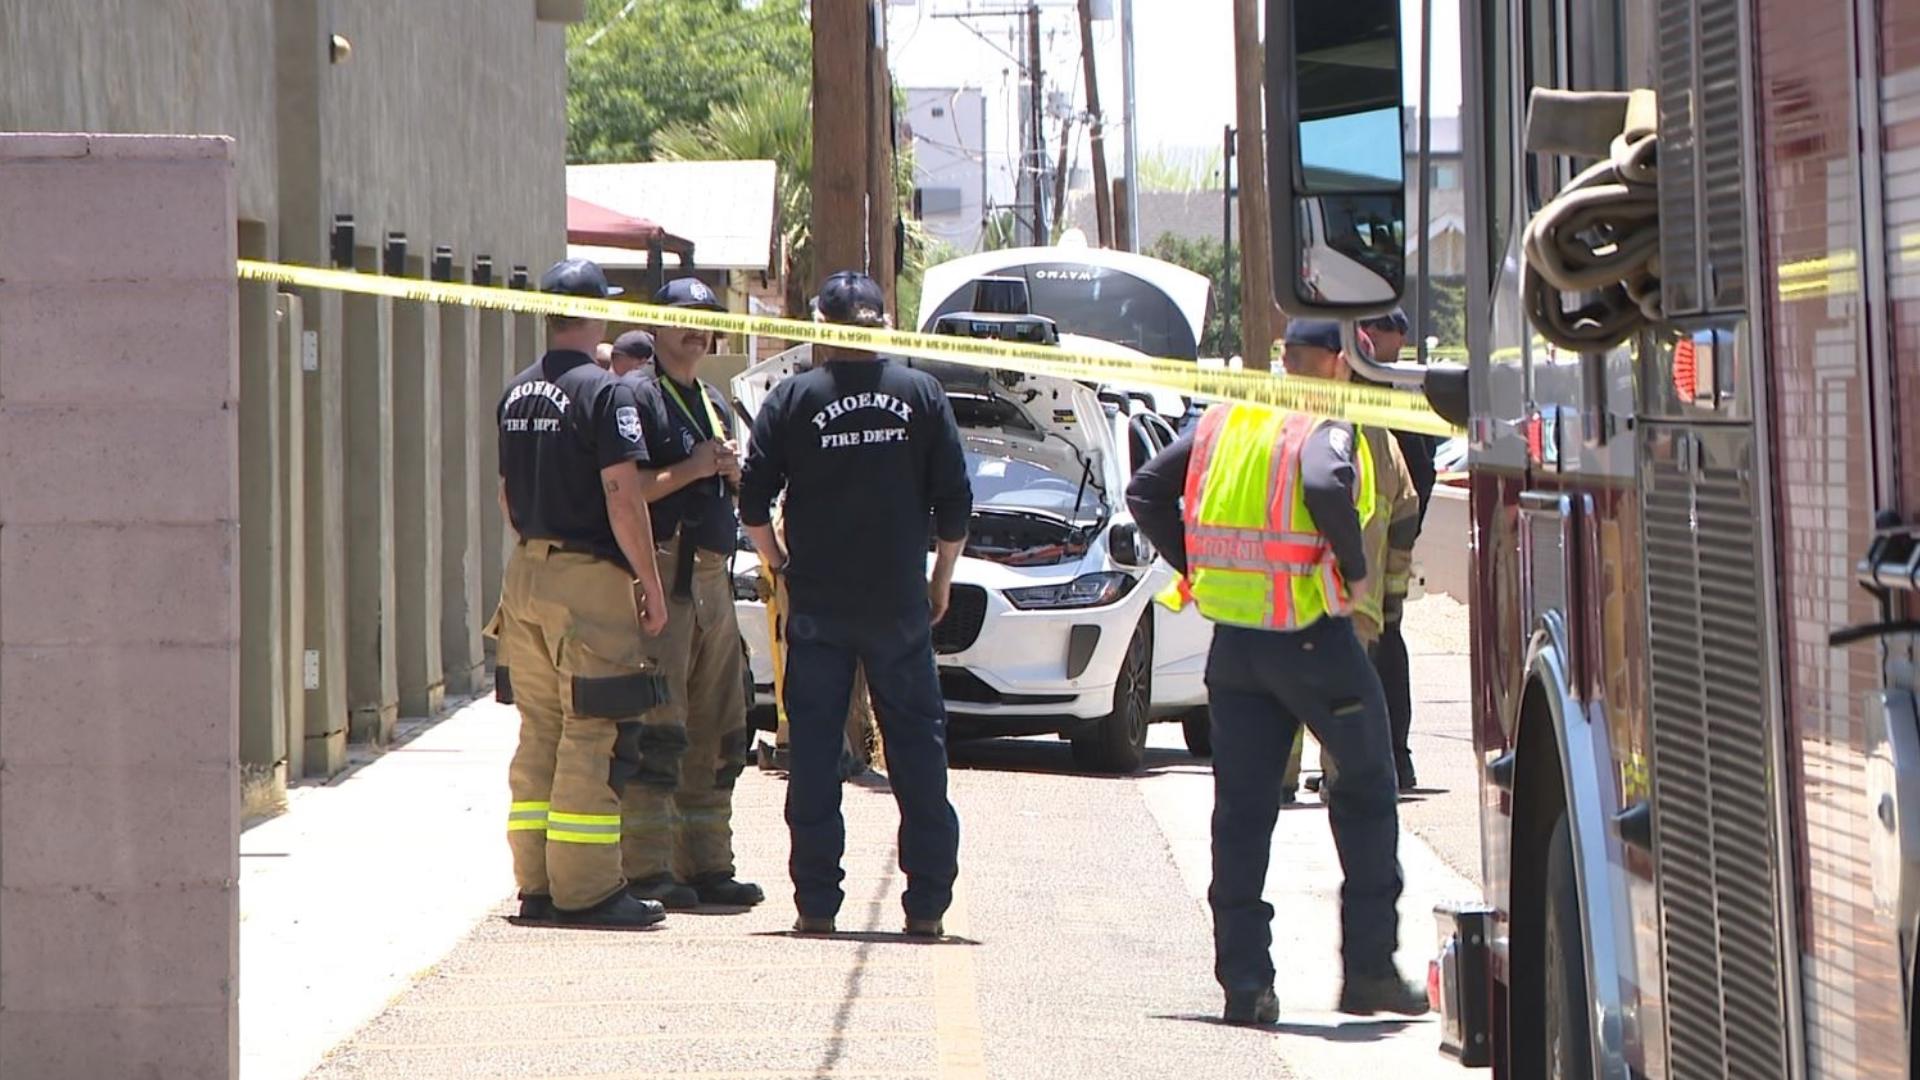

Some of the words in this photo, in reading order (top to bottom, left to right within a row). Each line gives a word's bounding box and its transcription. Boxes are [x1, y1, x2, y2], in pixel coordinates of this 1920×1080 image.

[1035, 270, 1092, 281] WAYMO
[811, 391, 913, 430] PHOENIX
[821, 432, 860, 448] FIRE
[863, 428, 909, 443] DEPT.
